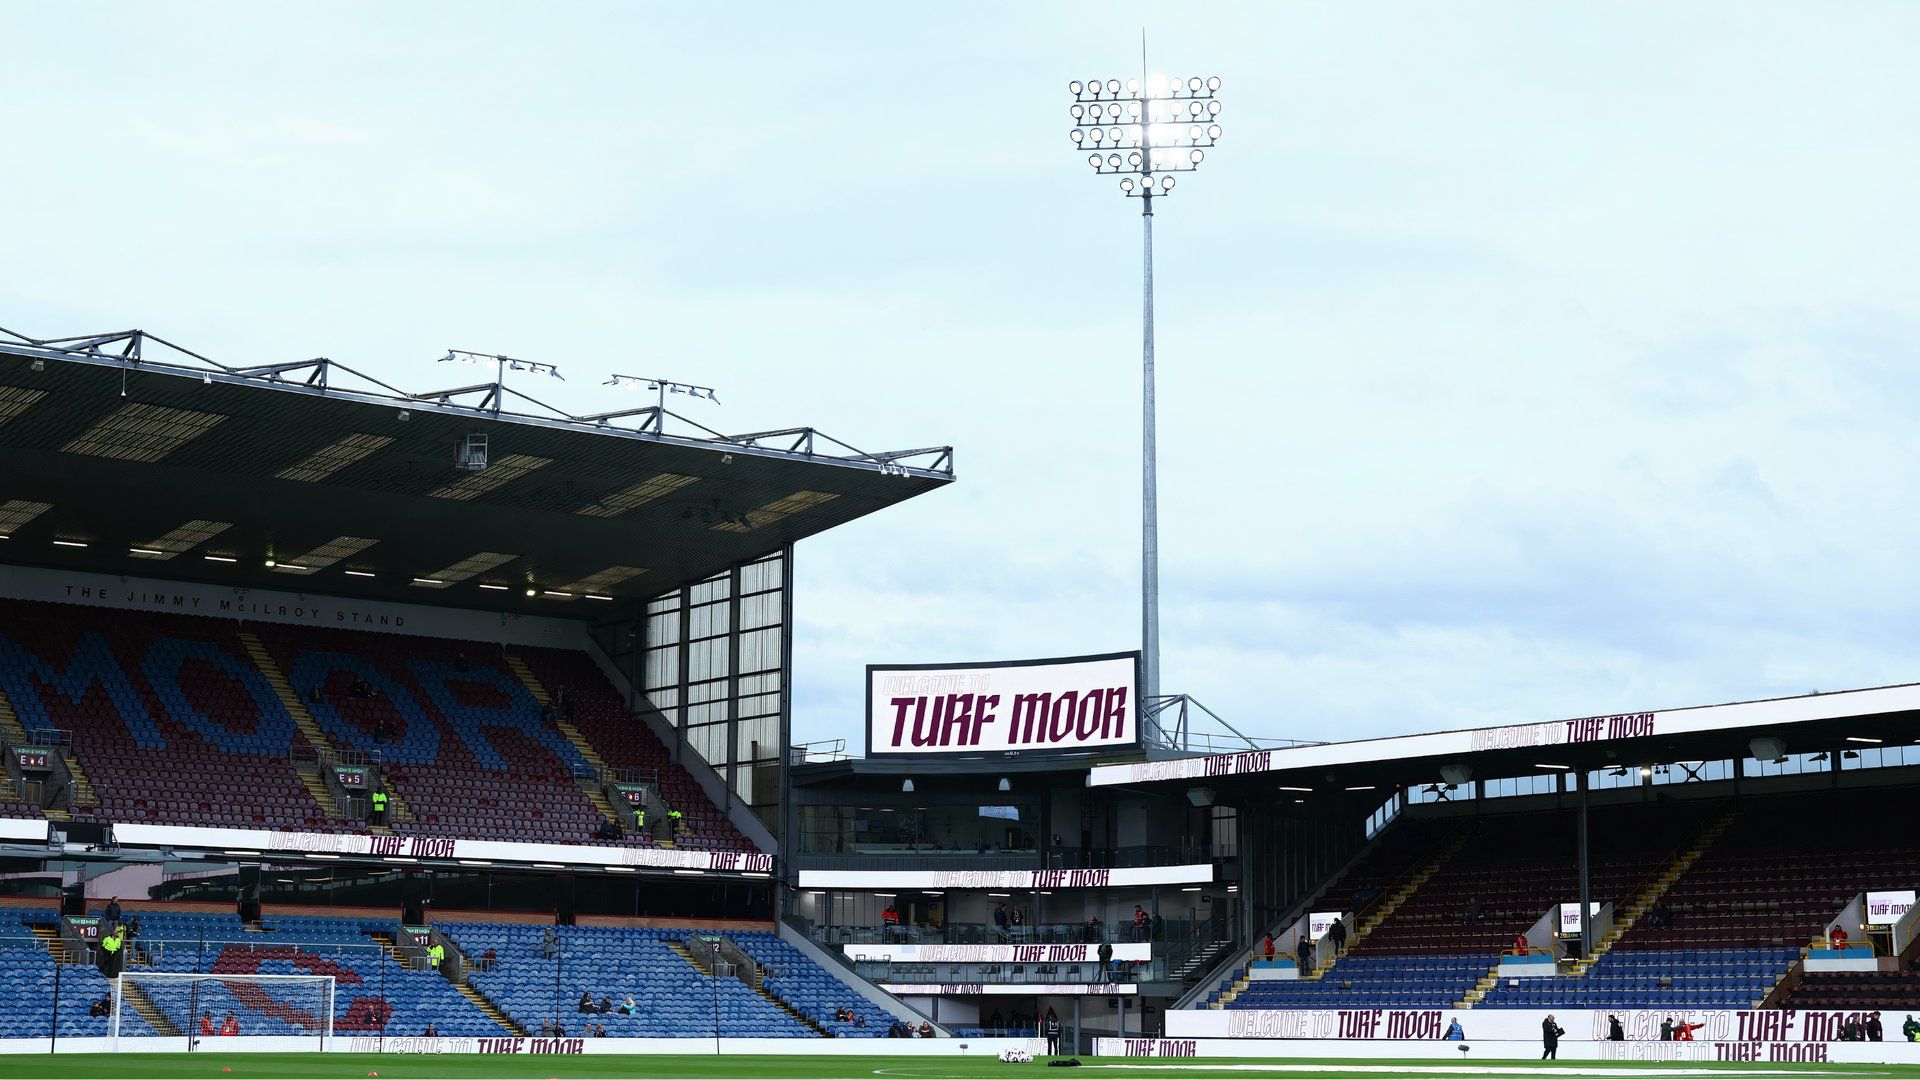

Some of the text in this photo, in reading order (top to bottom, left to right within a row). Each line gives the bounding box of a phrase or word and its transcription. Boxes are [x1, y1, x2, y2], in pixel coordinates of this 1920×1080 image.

[65, 586, 107, 599] THE
[127, 592, 200, 608] JIMMY
[337, 611, 404, 626] STAND
[882, 673, 990, 696] WELCOME TO
[890, 686, 1127, 747] TURF MOOR
[1471, 713, 1655, 751] WELCOME TO TURF MOOR
[20, 755, 44, 766] E 4
[1203, 753, 1234, 777] TURF
[1235, 751, 1271, 774] MOOR
[269, 831, 456, 858] WELCOME TO TURF MOOR
[690, 850, 707, 868] TO
[709, 852, 741, 870] TURF
[1008, 871, 1028, 887] TO
[1031, 869, 1067, 888] TURF
[1069, 868, 1110, 887] MOOR
[1563, 914, 1579, 925] TURF
[1870, 904, 1912, 915] TURF MOO
[86, 926, 98, 937] 10
[419, 935, 428, 945] 11
[992, 944, 1009, 961] TO
[1012, 945, 1046, 961] TURF
[1048, 944, 1087, 961] MOOR
[1228, 1009, 1442, 1039] WELCOME TO TURF MOOR
[1702, 1010, 1730, 1041] TO
[1736, 1009, 1796, 1041] TURF
[477, 1037, 525, 1054] TURF
[529, 1038, 584, 1055] MOOR
[1124, 1039, 1156, 1057] TURF
[1159, 1040, 1196, 1057] MOOR
[1687, 1041, 1710, 1061] TO
[1714, 1042, 1763, 1062] TURF
[1770, 1042, 1828, 1062] MOOR
